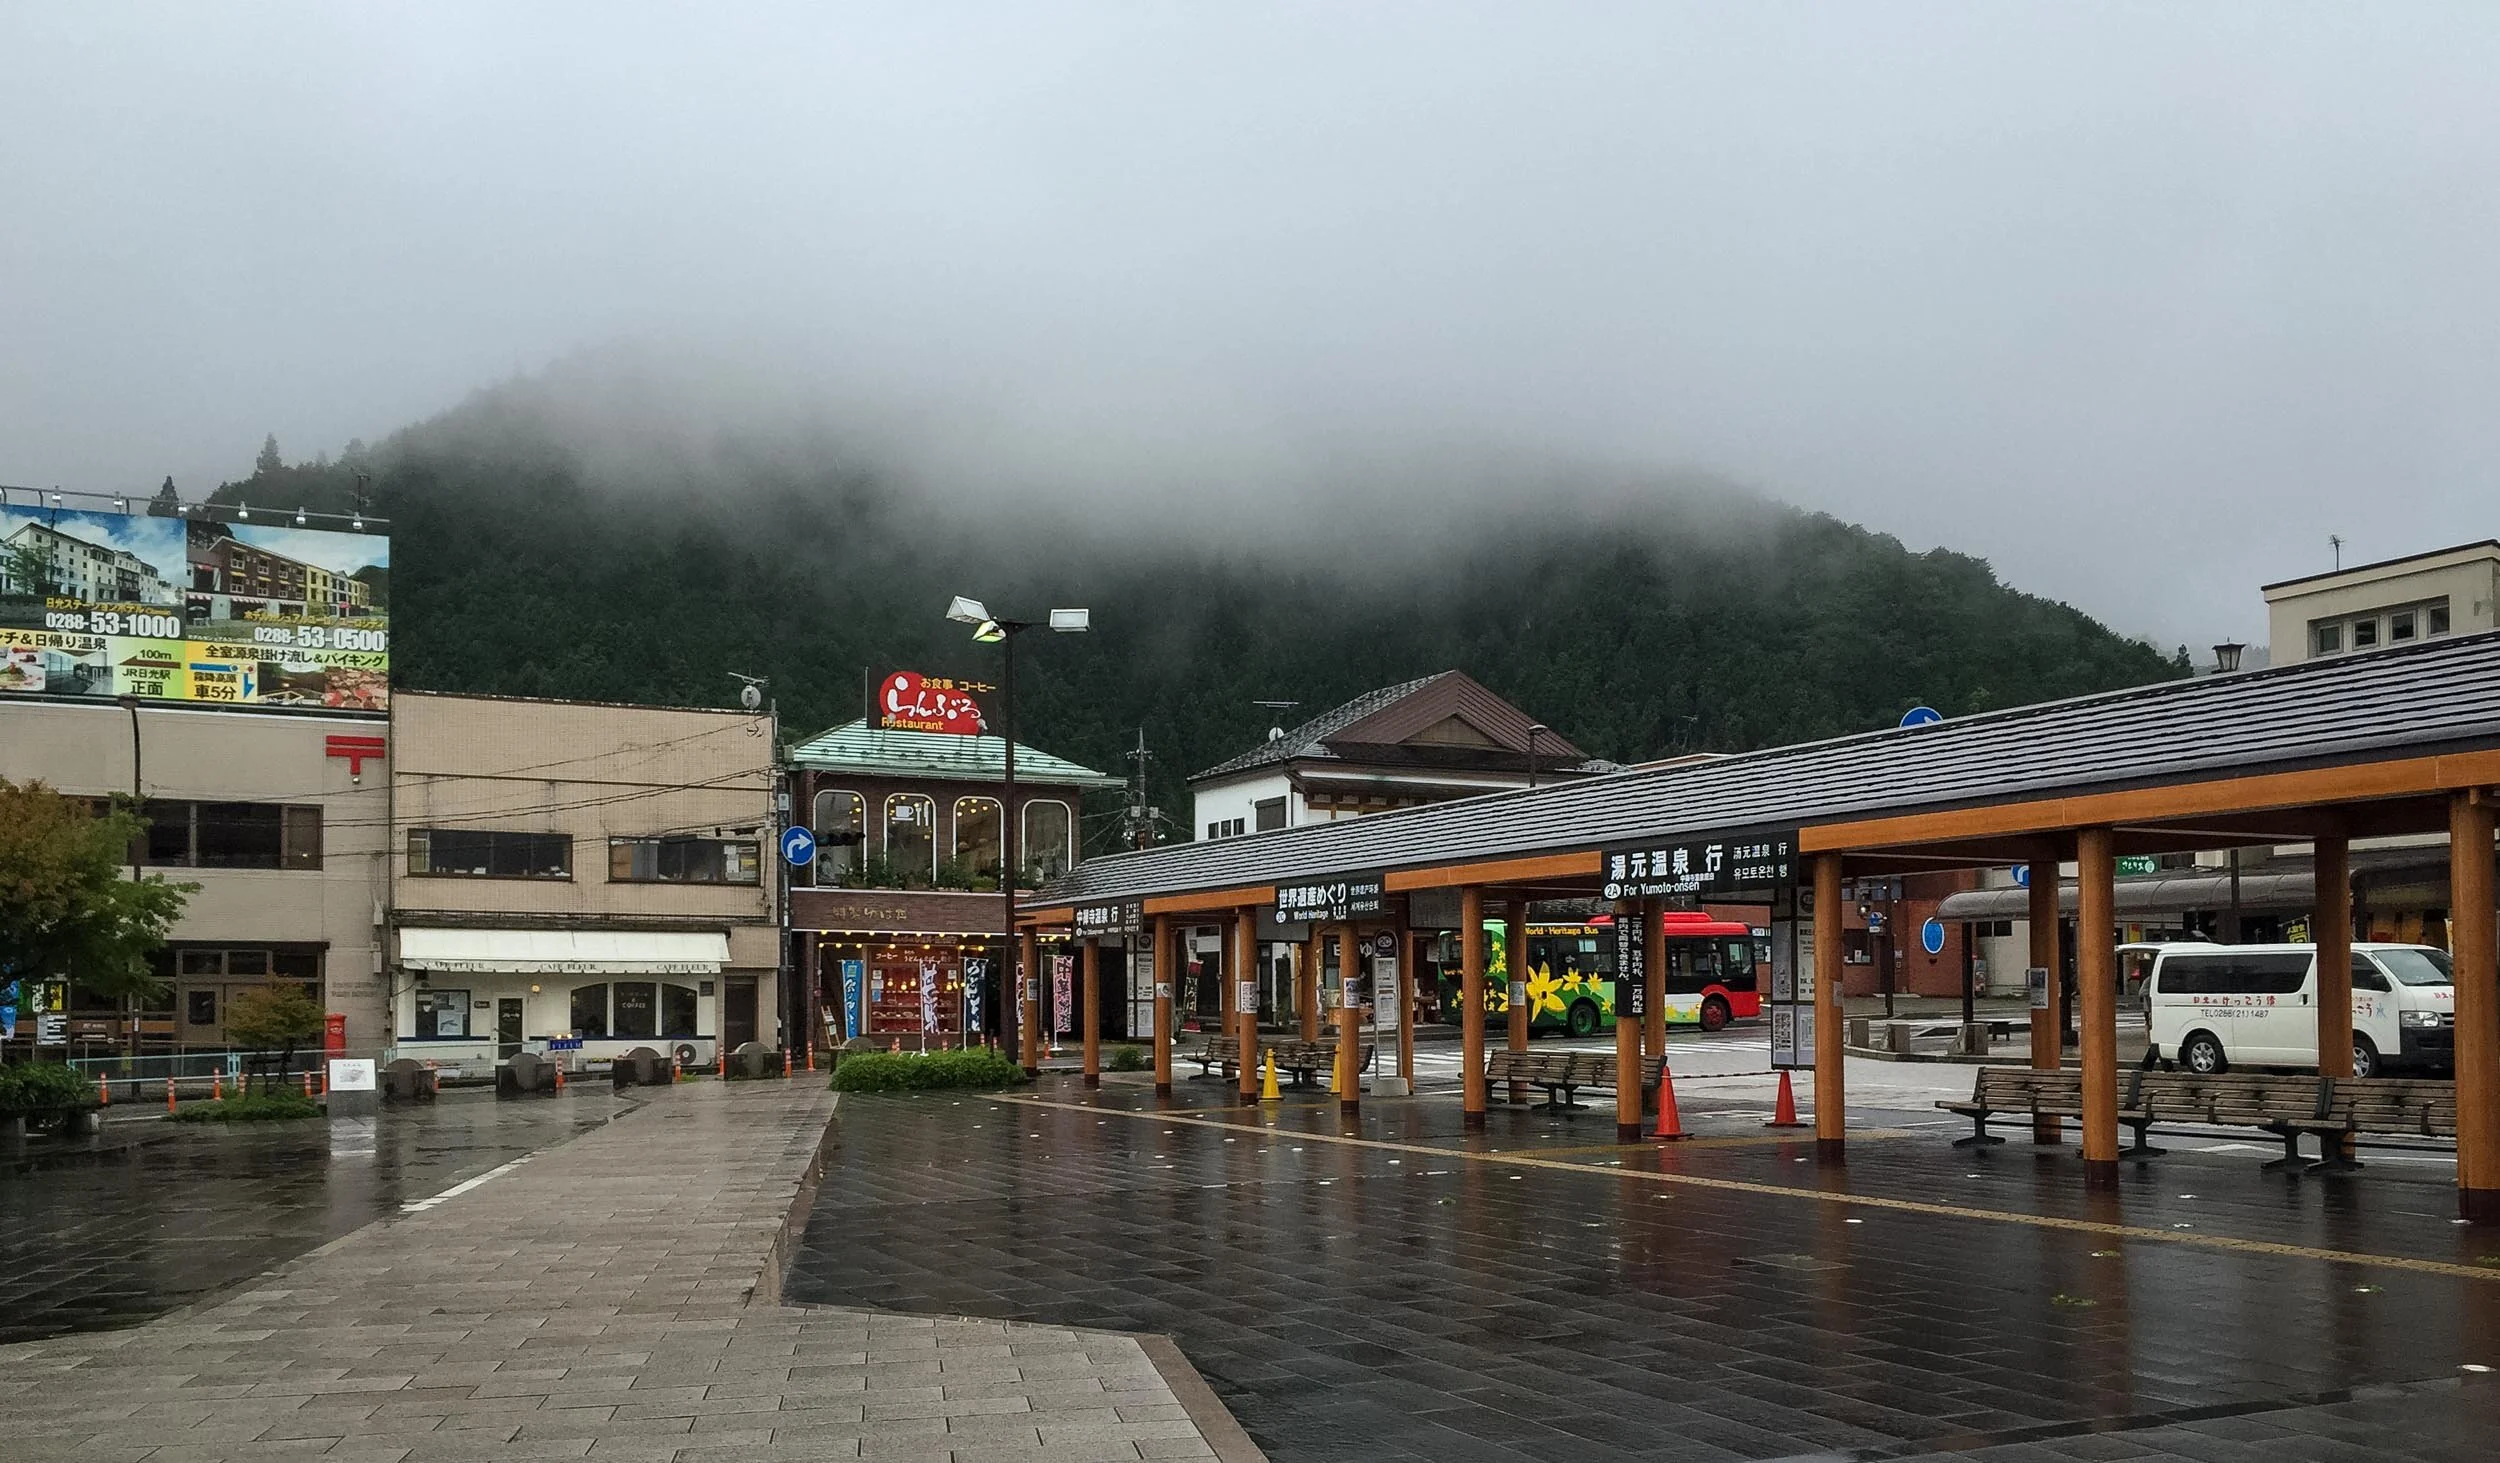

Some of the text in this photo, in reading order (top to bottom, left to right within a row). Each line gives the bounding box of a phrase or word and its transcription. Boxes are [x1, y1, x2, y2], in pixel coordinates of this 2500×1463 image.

[45, 611, 181, 638] 0288-53-1000
[254, 625, 385, 651] 0288-53-0500
[140, 649, 172, 660] 100m
[122, 668, 171, 680] JR日光駅
[131, 680, 164, 696] 正面
[194, 684, 237, 700] 車5分
[920, 678, 996, 692] お食事 コーヒー
[1778, 842, 1788, 855] 行
[1610, 844, 1723, 880] 湯元温泉 行
[1733, 864, 1788, 880] 유모토온천 행
[1279, 883, 1346, 909] 世界遺産めぐり
[1623, 884, 1638, 897] For
[1640, 881, 1700, 895] Yumoto-onsen
[1110, 906, 1118, 923] 行
[1548, 926, 1581, 936] Heritage
[1584, 926, 1599, 935] Bus
[876, 952, 898, 960] コーヒー
